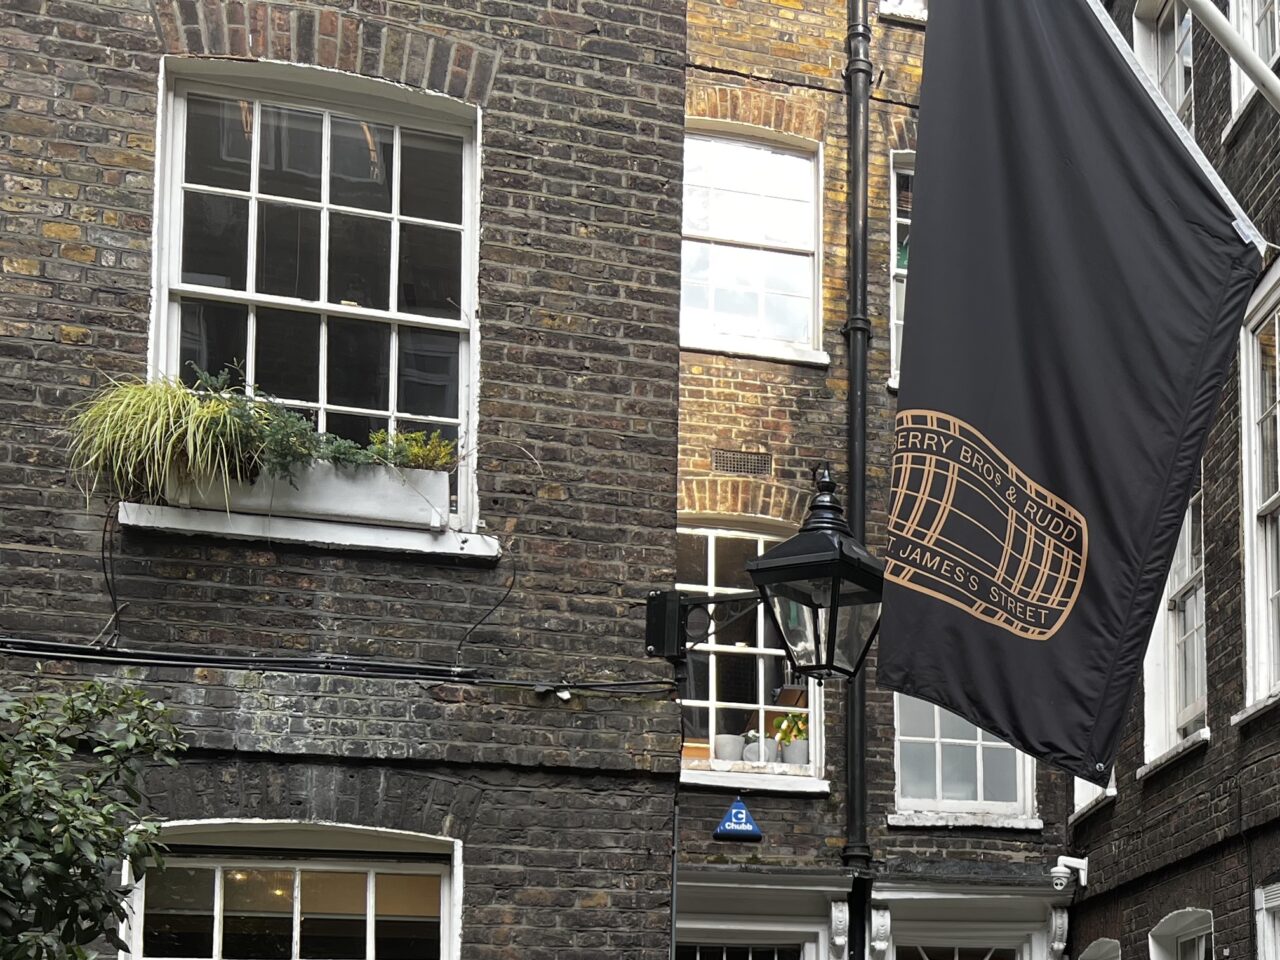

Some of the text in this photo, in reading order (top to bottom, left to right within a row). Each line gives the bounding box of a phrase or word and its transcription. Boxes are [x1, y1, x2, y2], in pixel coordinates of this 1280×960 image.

[1005, 485, 1018, 504] &
[1023, 502, 1078, 543] RUDD
[899, 544, 980, 592] JAMES'S
[989, 586, 1049, 625] STREET
[725, 822, 753, 831] Chubb
